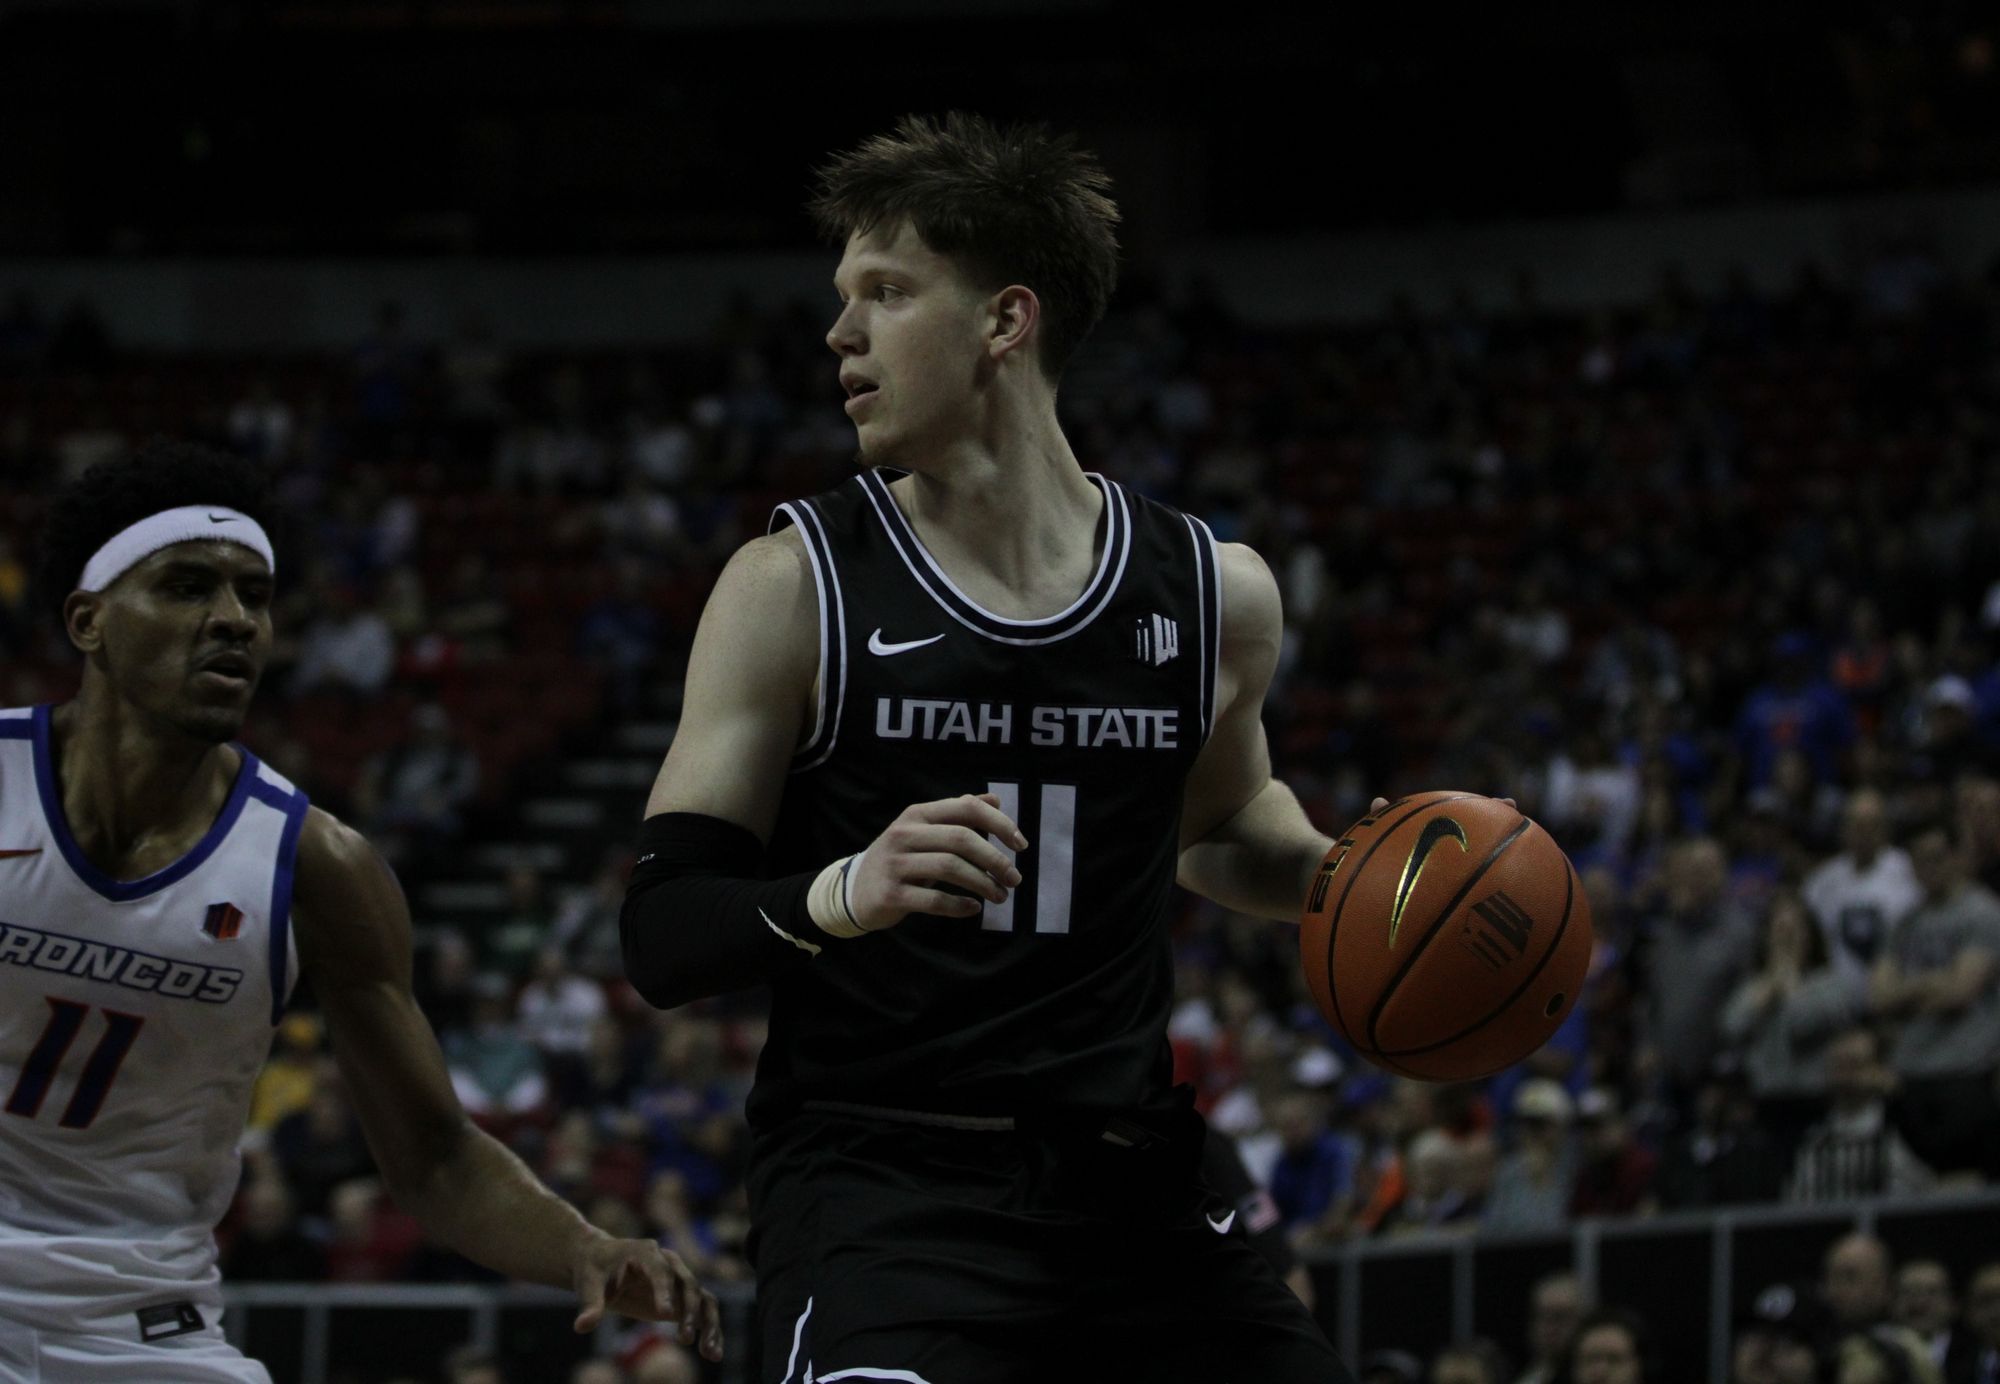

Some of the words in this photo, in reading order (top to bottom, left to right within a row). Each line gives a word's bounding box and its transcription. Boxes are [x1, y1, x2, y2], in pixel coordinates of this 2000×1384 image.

[874, 696, 1014, 745] UTAH
[1030, 704, 1180, 750] STATE
[979, 780, 1079, 936] 11
[0, 922, 243, 1004] RONCOS
[5, 996, 145, 1130] 11
